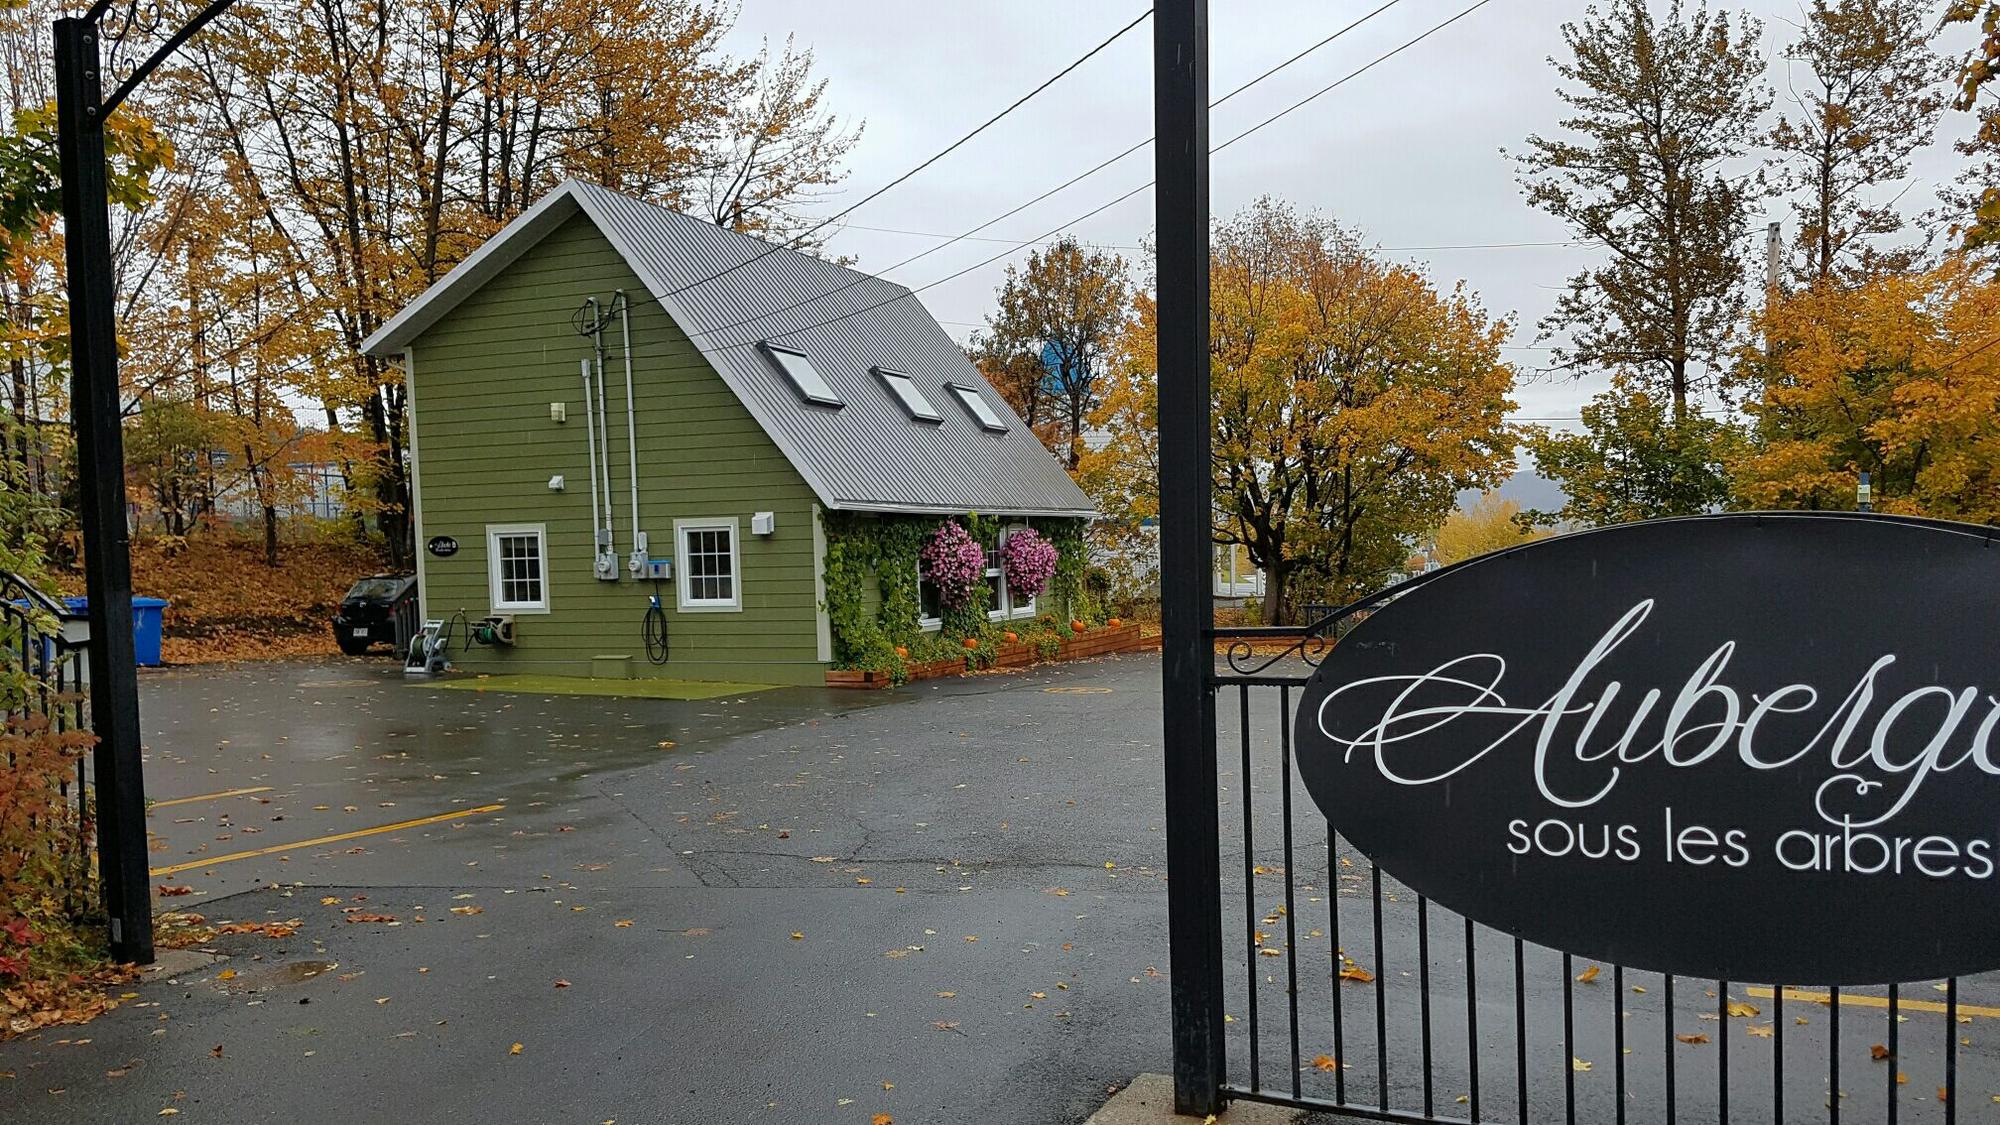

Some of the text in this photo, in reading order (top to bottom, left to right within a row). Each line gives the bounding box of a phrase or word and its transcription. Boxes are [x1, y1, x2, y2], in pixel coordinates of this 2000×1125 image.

[1506, 806, 1995, 879] sous les arbres
